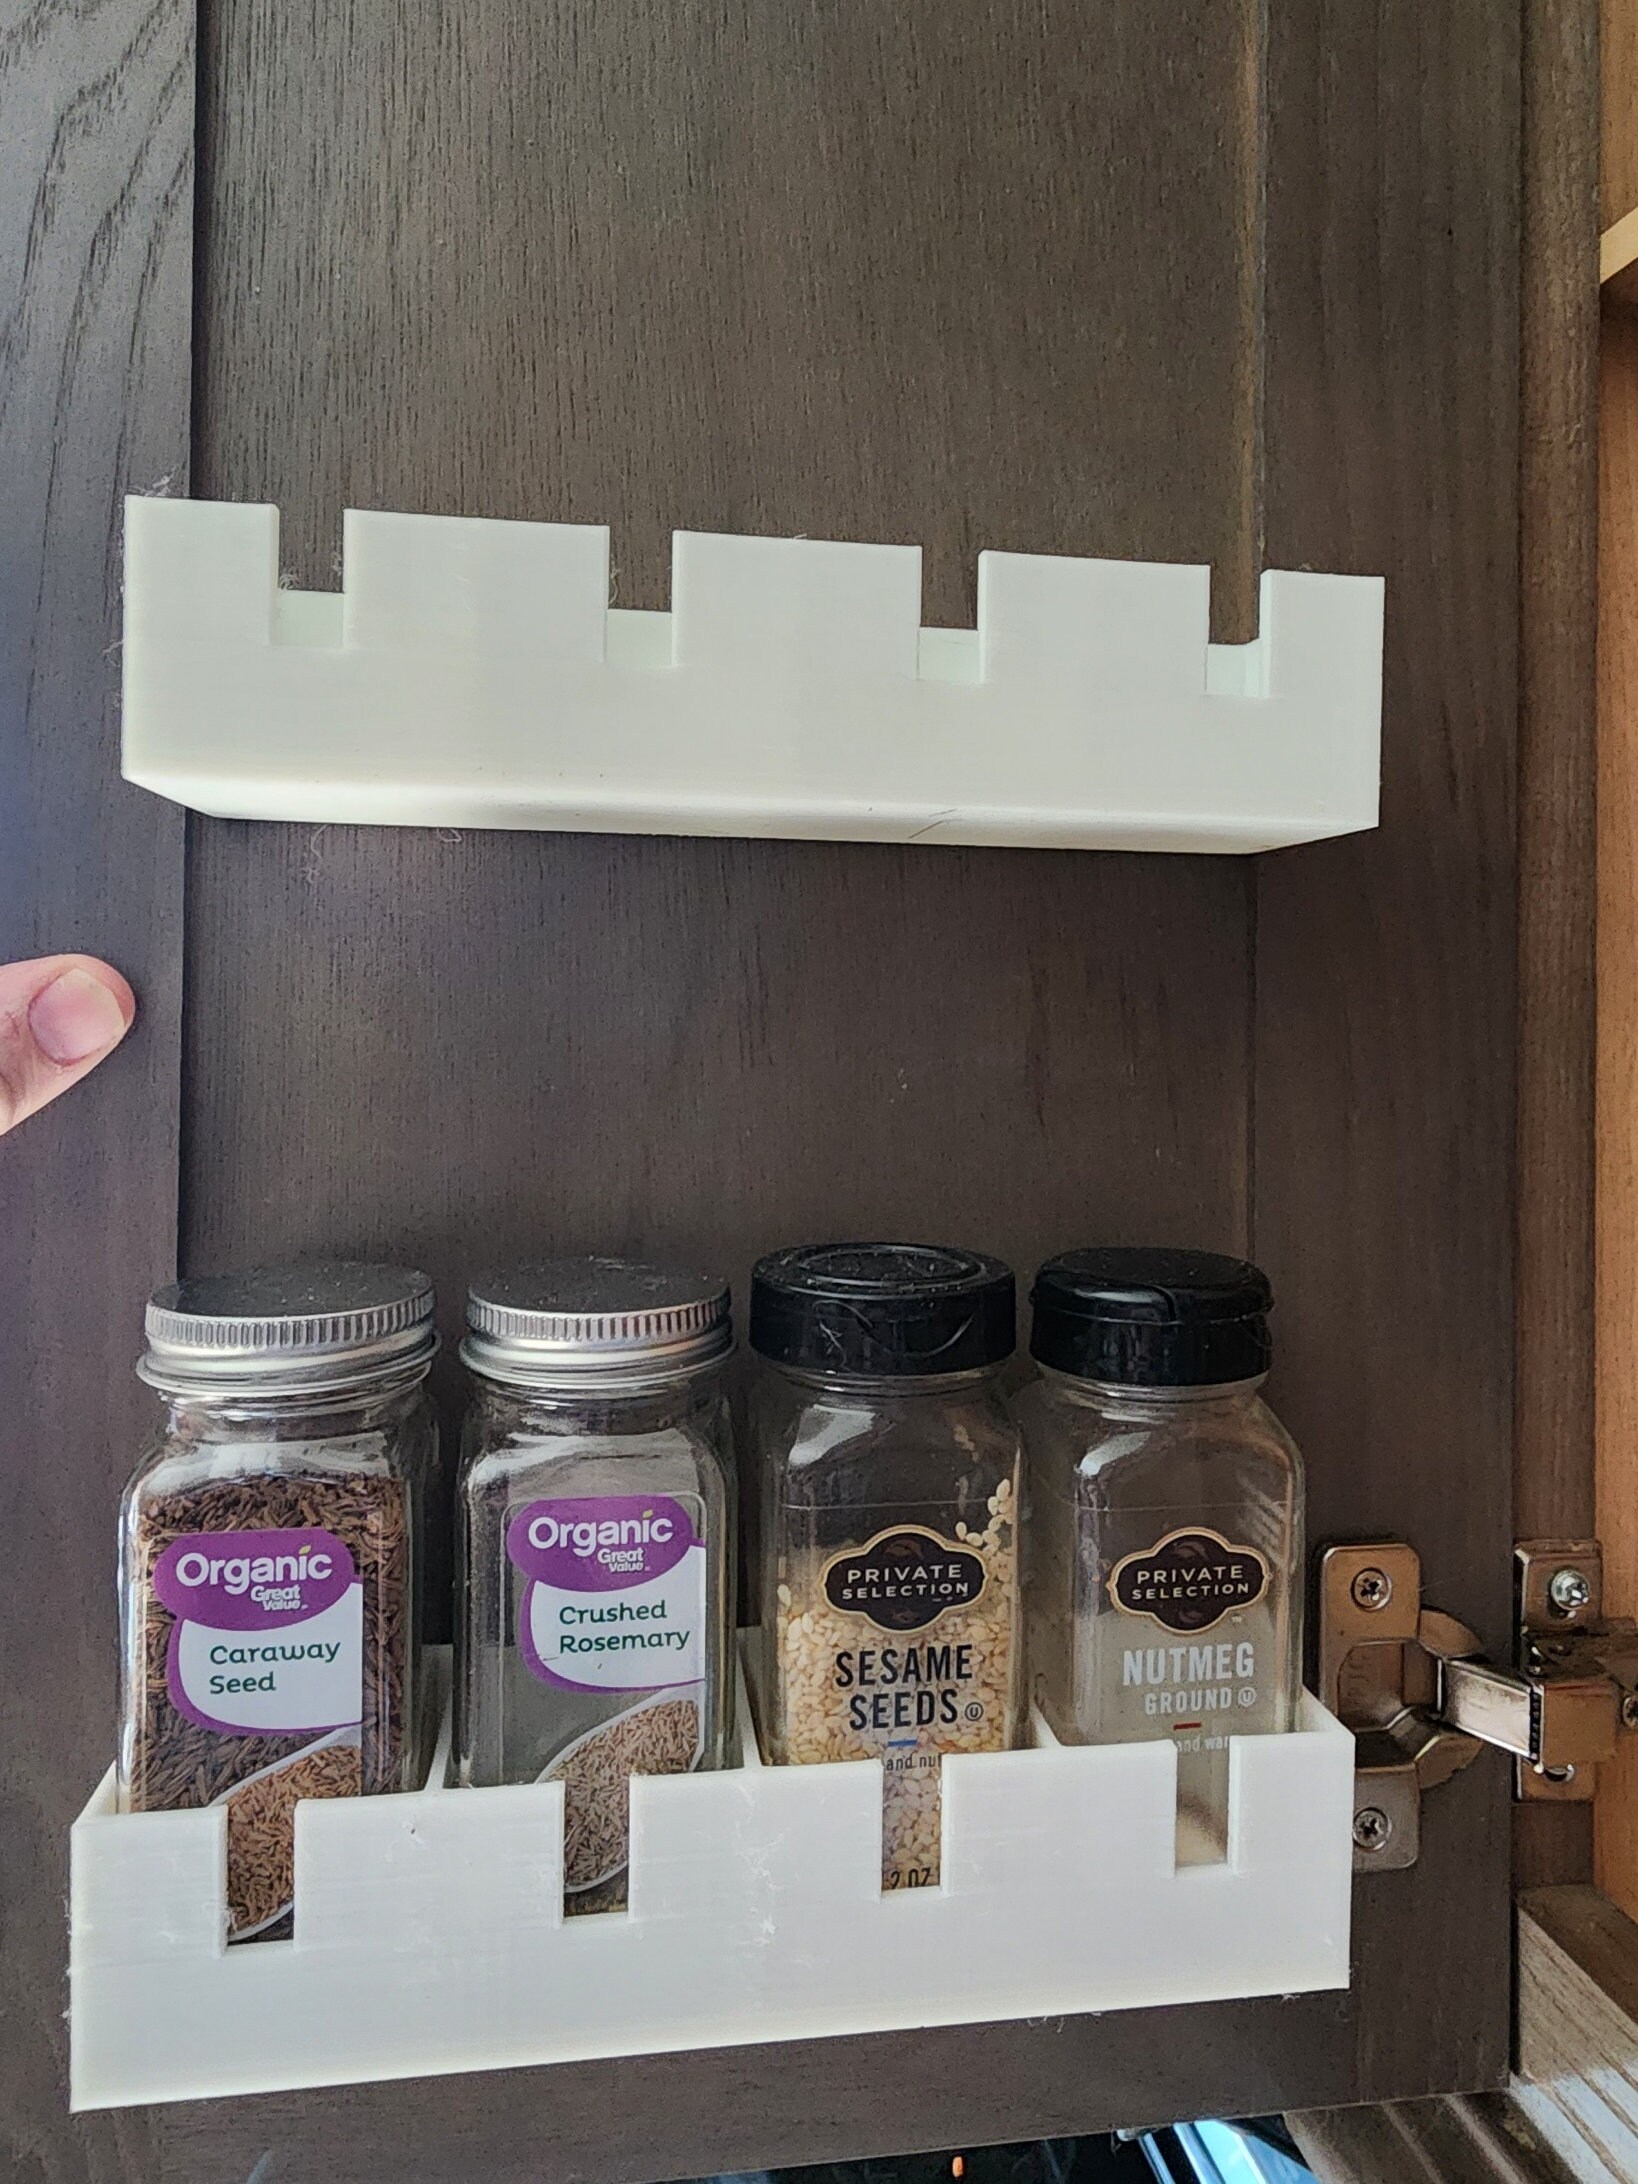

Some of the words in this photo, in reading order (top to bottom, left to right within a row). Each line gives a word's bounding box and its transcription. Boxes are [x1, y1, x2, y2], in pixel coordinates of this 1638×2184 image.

[528, 1510, 674, 1557] Organic
[597, 1547, 644, 1564] Great
[608, 1561, 644, 1573] Value
[175, 1546, 332, 1594] Organic
[847, 1563, 963, 1584] PRIVATE
[1136, 1565, 1244, 1585] PRIVATE
[250, 1584, 301, 1602] Great
[841, 1582, 969, 1601] SELECTION
[1131, 1583, 1250, 1601] SELECTION
[262, 1599, 301, 1612] Value
[559, 1600, 668, 1626] Crushed
[209, 1642, 342, 1666] Caraway
[558, 1630, 691, 1655] Rosemary
[835, 1644, 974, 1688] SESAME
[1122, 1641, 1256, 1686] NUTMEG
[209, 1672, 276, 1695] Seed
[848, 1689, 959, 1732] SEEDS
[1144, 1687, 1233, 1717] GROUND
[886, 1752, 914, 1772] and
